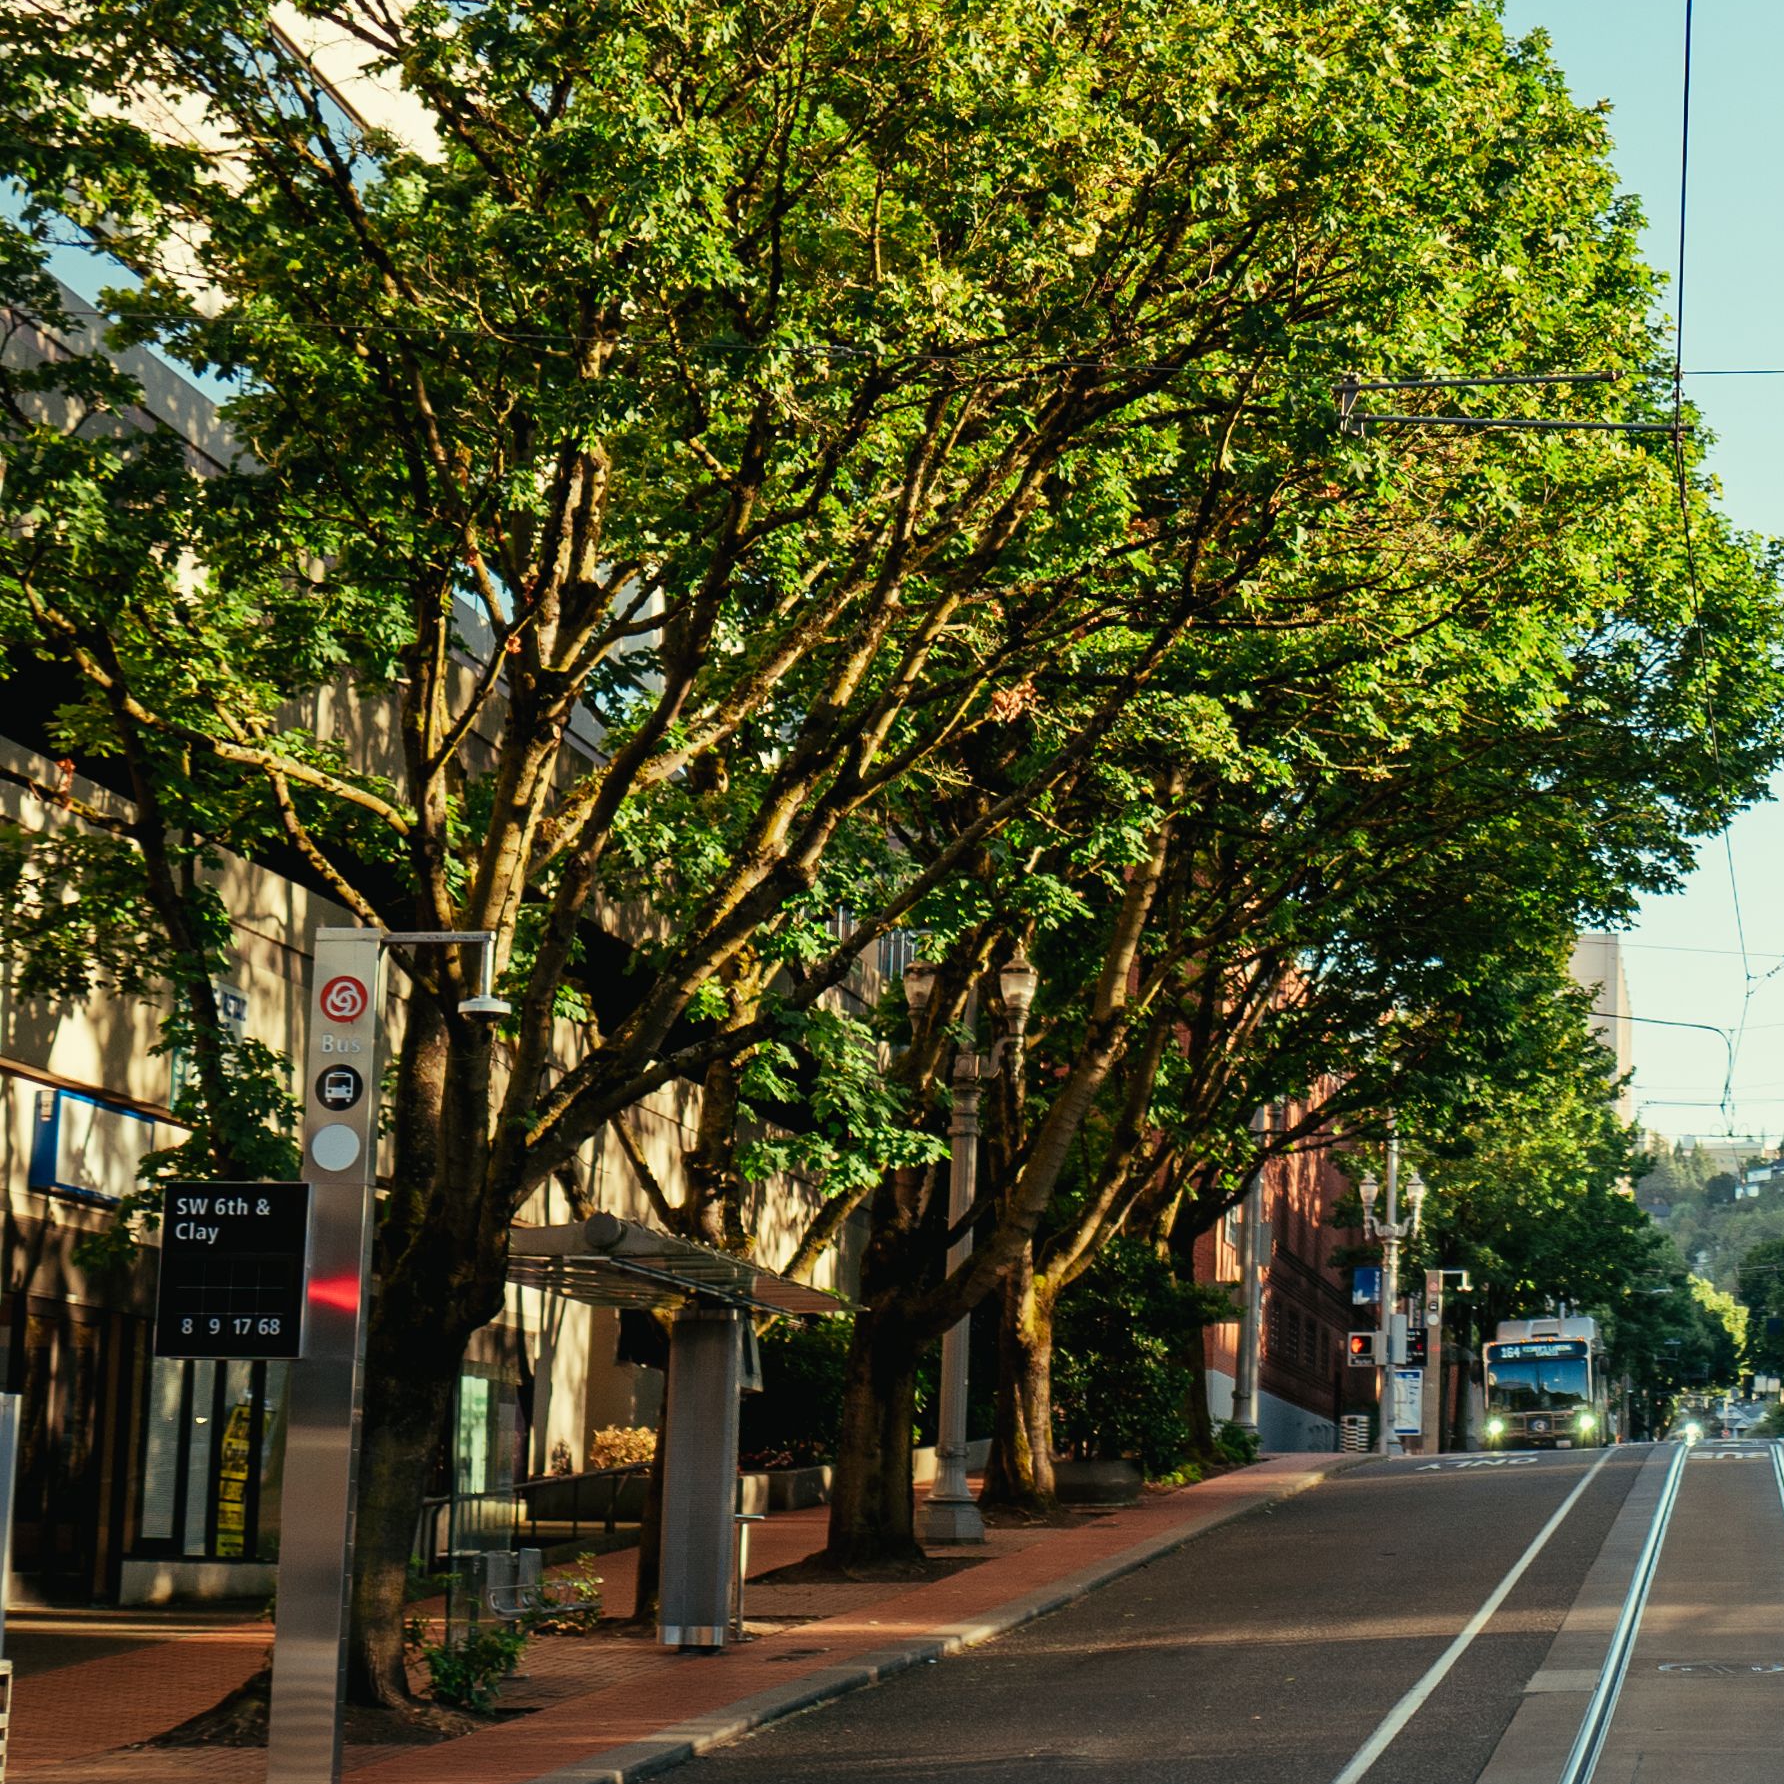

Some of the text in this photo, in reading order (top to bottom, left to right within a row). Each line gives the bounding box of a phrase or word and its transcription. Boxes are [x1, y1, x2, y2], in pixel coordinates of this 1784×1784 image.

[320, 1034, 361, 1053] Bus
[176, 1197, 271, 1216] SW 6th &
[175, 1222, 220, 1245] Clay
[181, 1318, 281, 1335] 8 9 17 68
[1500, 1346, 1521, 1358] 164
